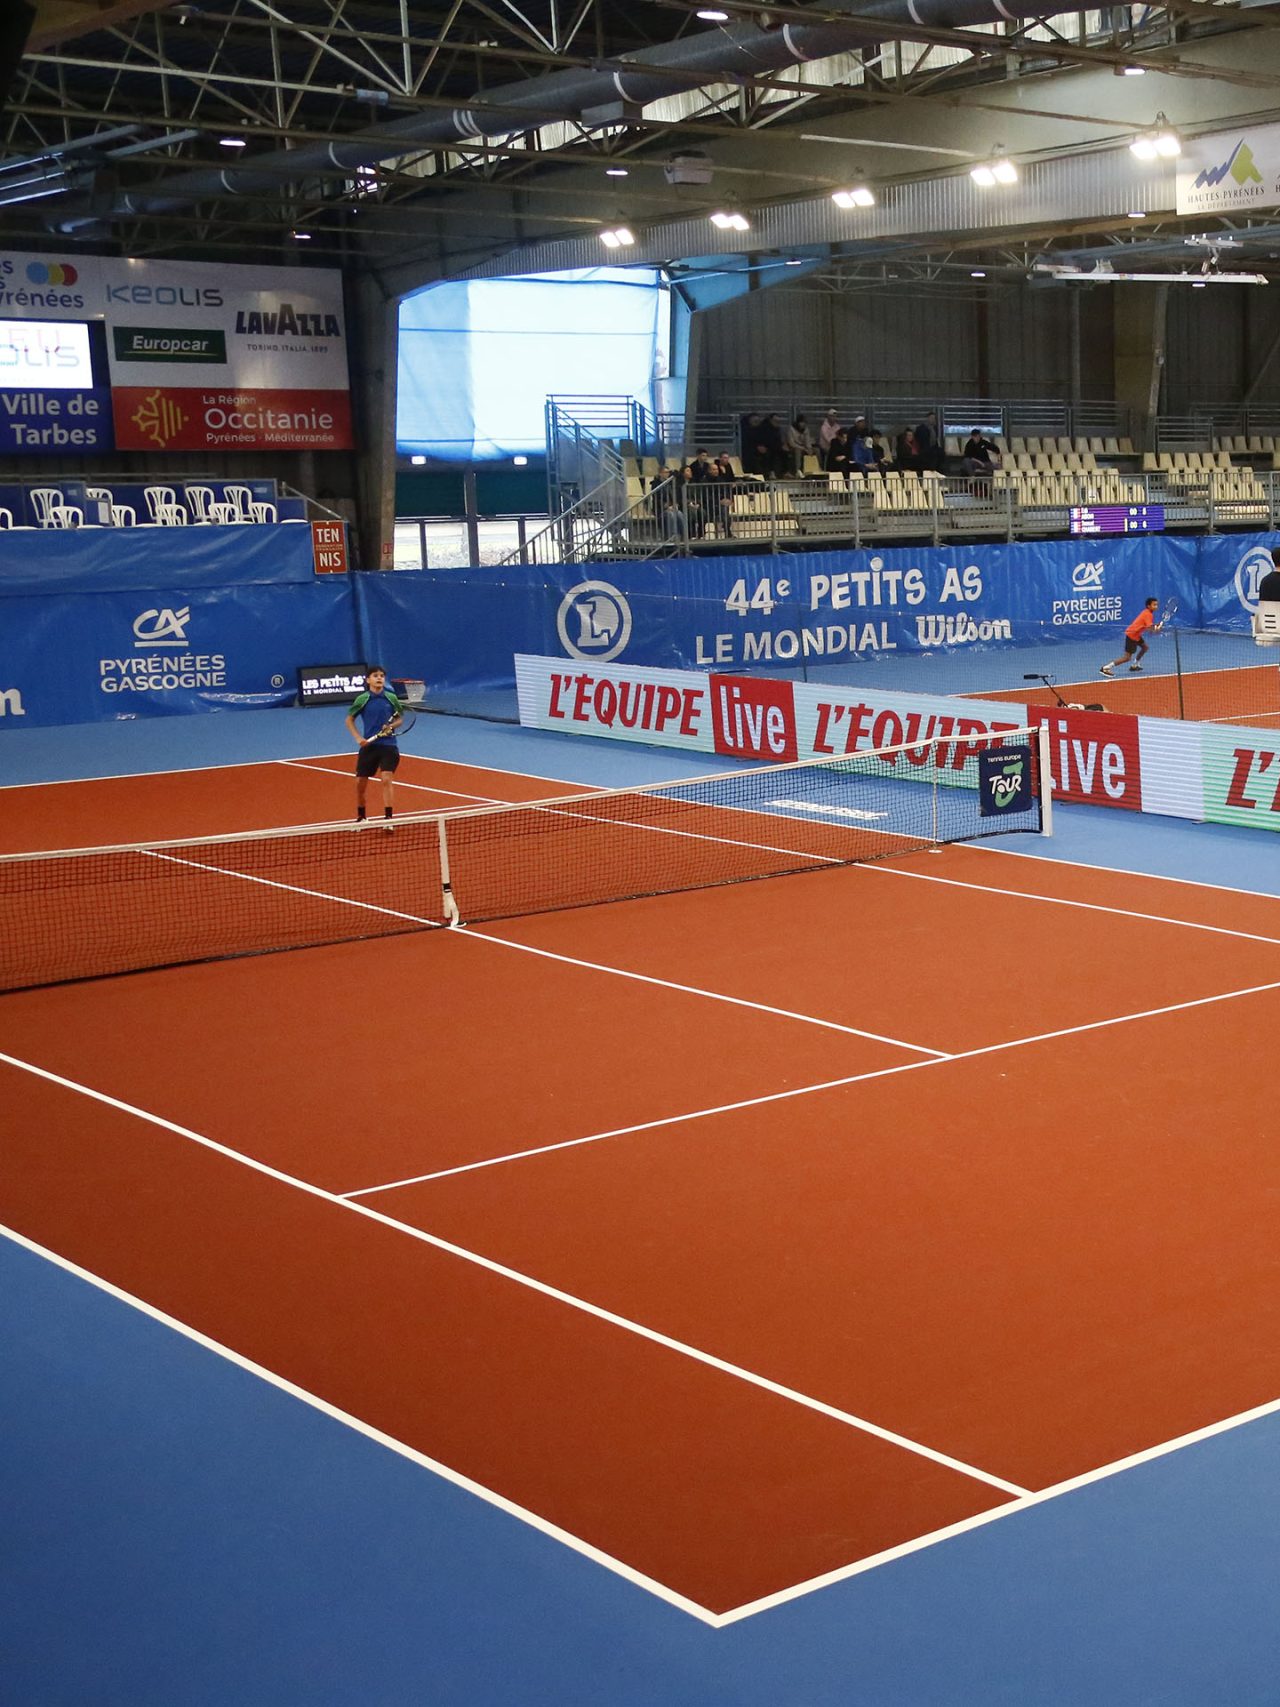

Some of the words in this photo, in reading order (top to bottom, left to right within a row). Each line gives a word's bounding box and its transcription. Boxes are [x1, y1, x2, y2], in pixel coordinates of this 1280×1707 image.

[236, 304, 340, 337] LAVAZZA
[132, 335, 209, 354] Europcar
[1, 393, 60, 415] Ville
[67, 393, 99, 415] de
[203, 395, 215, 404] La
[218, 395, 256, 407] Région
[205, 408, 333, 429] Occitanie
[10, 423, 97, 445] Tarbes
[206, 433, 256, 444] Pyrénées
[264, 432, 335, 442] Méditerranée
[316, 528, 340, 543] TEN
[320, 552, 342, 567] NIS
[726, 578, 790, 617] 44e
[810, 557, 926, 611] PETITS
[939, 565, 983, 602] AS
[1053, 595, 1122, 613] PYRÉNÉES
[1053, 609, 1122, 625] GASCOGNE
[696, 634, 733, 664] LE
[743, 621, 897, 661] MONDIAL
[915, 612, 1012, 646] Wilson
[100, 652, 226, 675] PYRÉNÉES
[101, 671, 226, 693] GASCOGNE
[302, 679, 319, 690] LES
[320, 674, 350, 688] PETITS
[314, 687, 343, 695] MONDIAL
[549, 673, 704, 737] L'ÉQUIPE
[720, 685, 786, 754] live
[1042, 716, 1127, 799] ive
